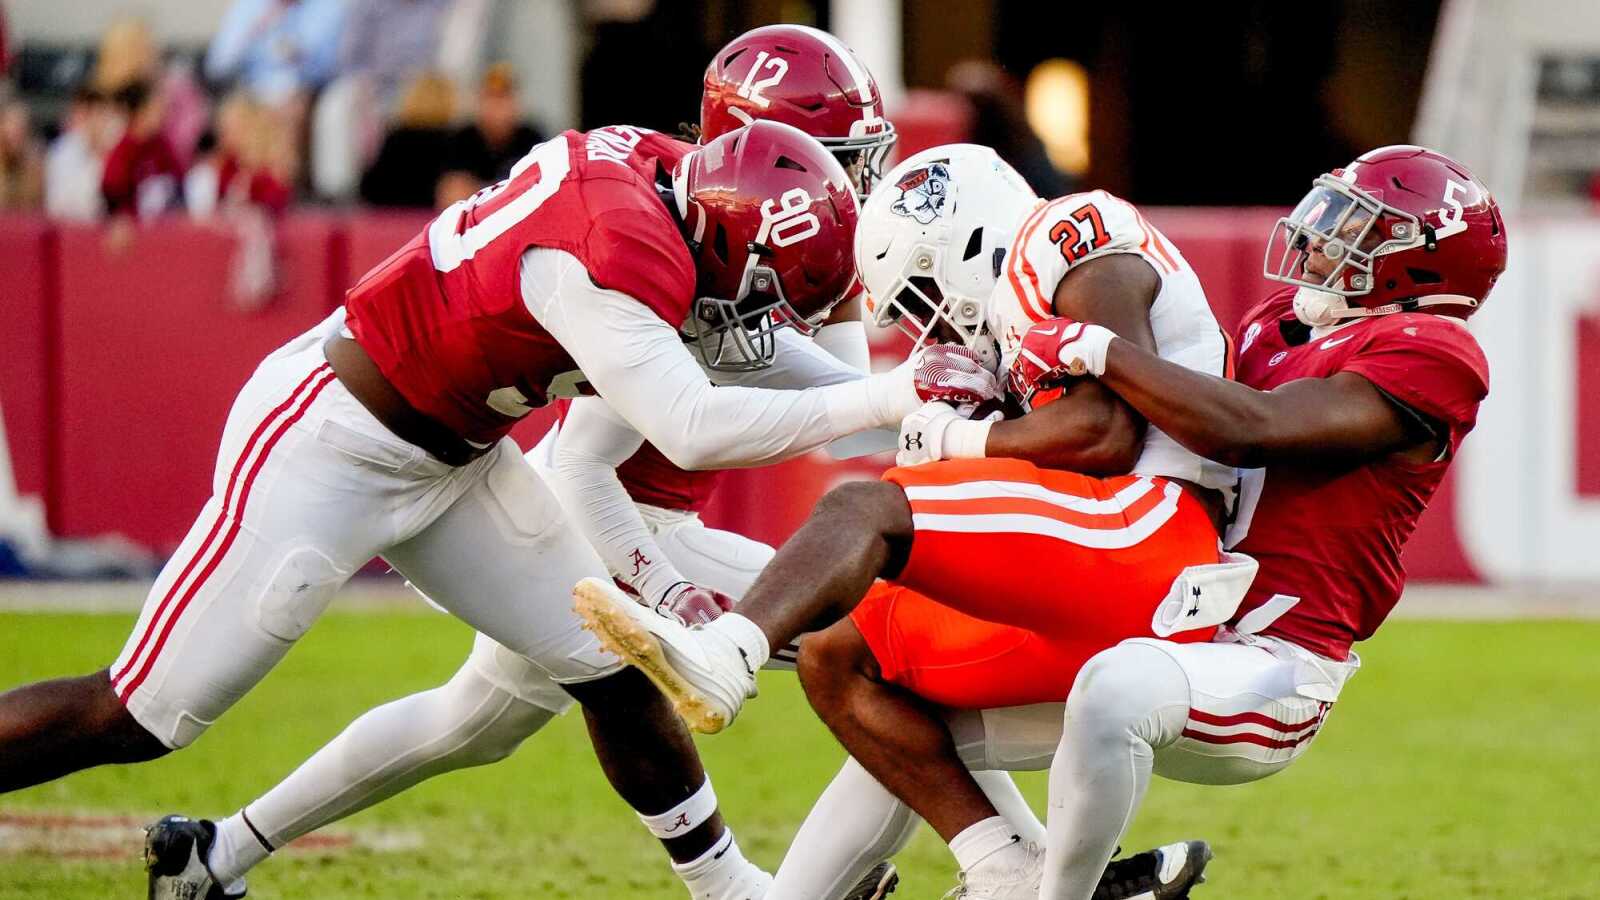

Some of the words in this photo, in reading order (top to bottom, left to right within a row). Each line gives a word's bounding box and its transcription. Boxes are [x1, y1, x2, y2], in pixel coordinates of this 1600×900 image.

[736, 51, 789, 108] 12
[757, 187, 821, 248] 90
[1438, 178, 1468, 226] 5
[1049, 202, 1112, 267] 27
